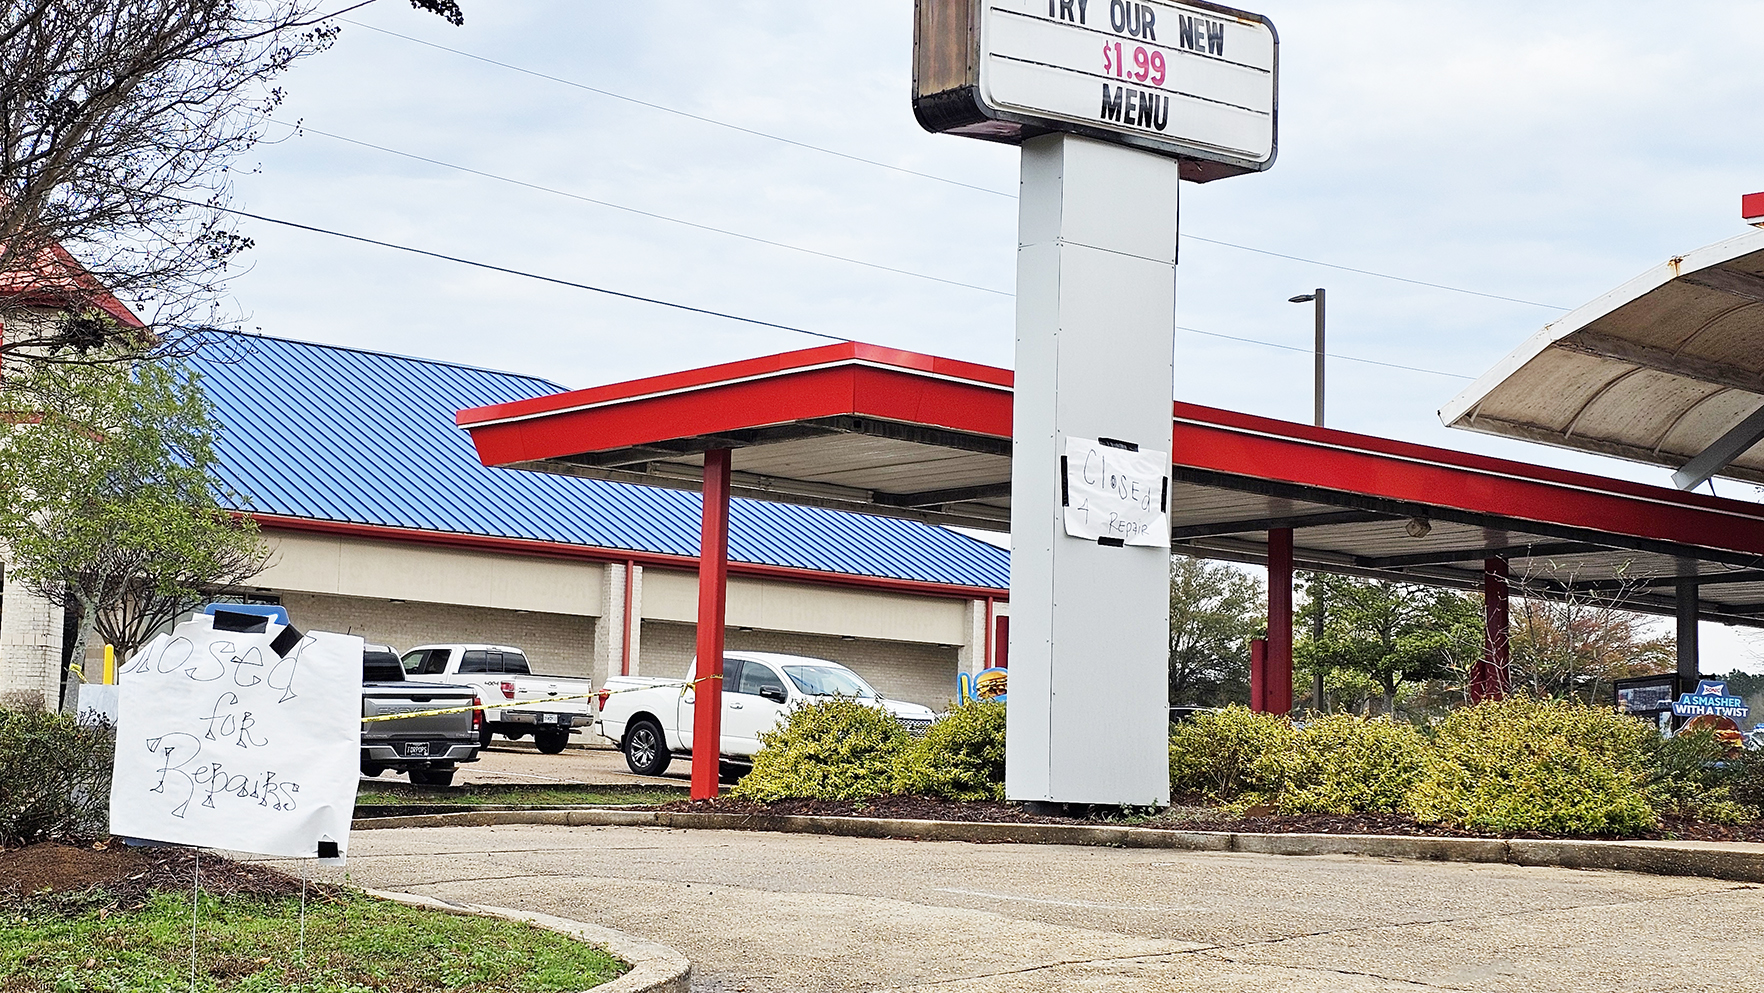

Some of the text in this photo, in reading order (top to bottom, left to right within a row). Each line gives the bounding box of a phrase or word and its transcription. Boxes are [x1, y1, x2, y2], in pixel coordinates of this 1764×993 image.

[1110, 0, 1156, 41] OUR
[1178, 14, 1224, 56] NEW
[1103, 40, 1166, 86] $1.99
[1100, 83, 1169, 131] MENU
[1077, 498, 1089, 525] 4
[1675, 704, 1748, 717] WITH A TWIST
[1683, 696, 1741, 707] A SMASHER
